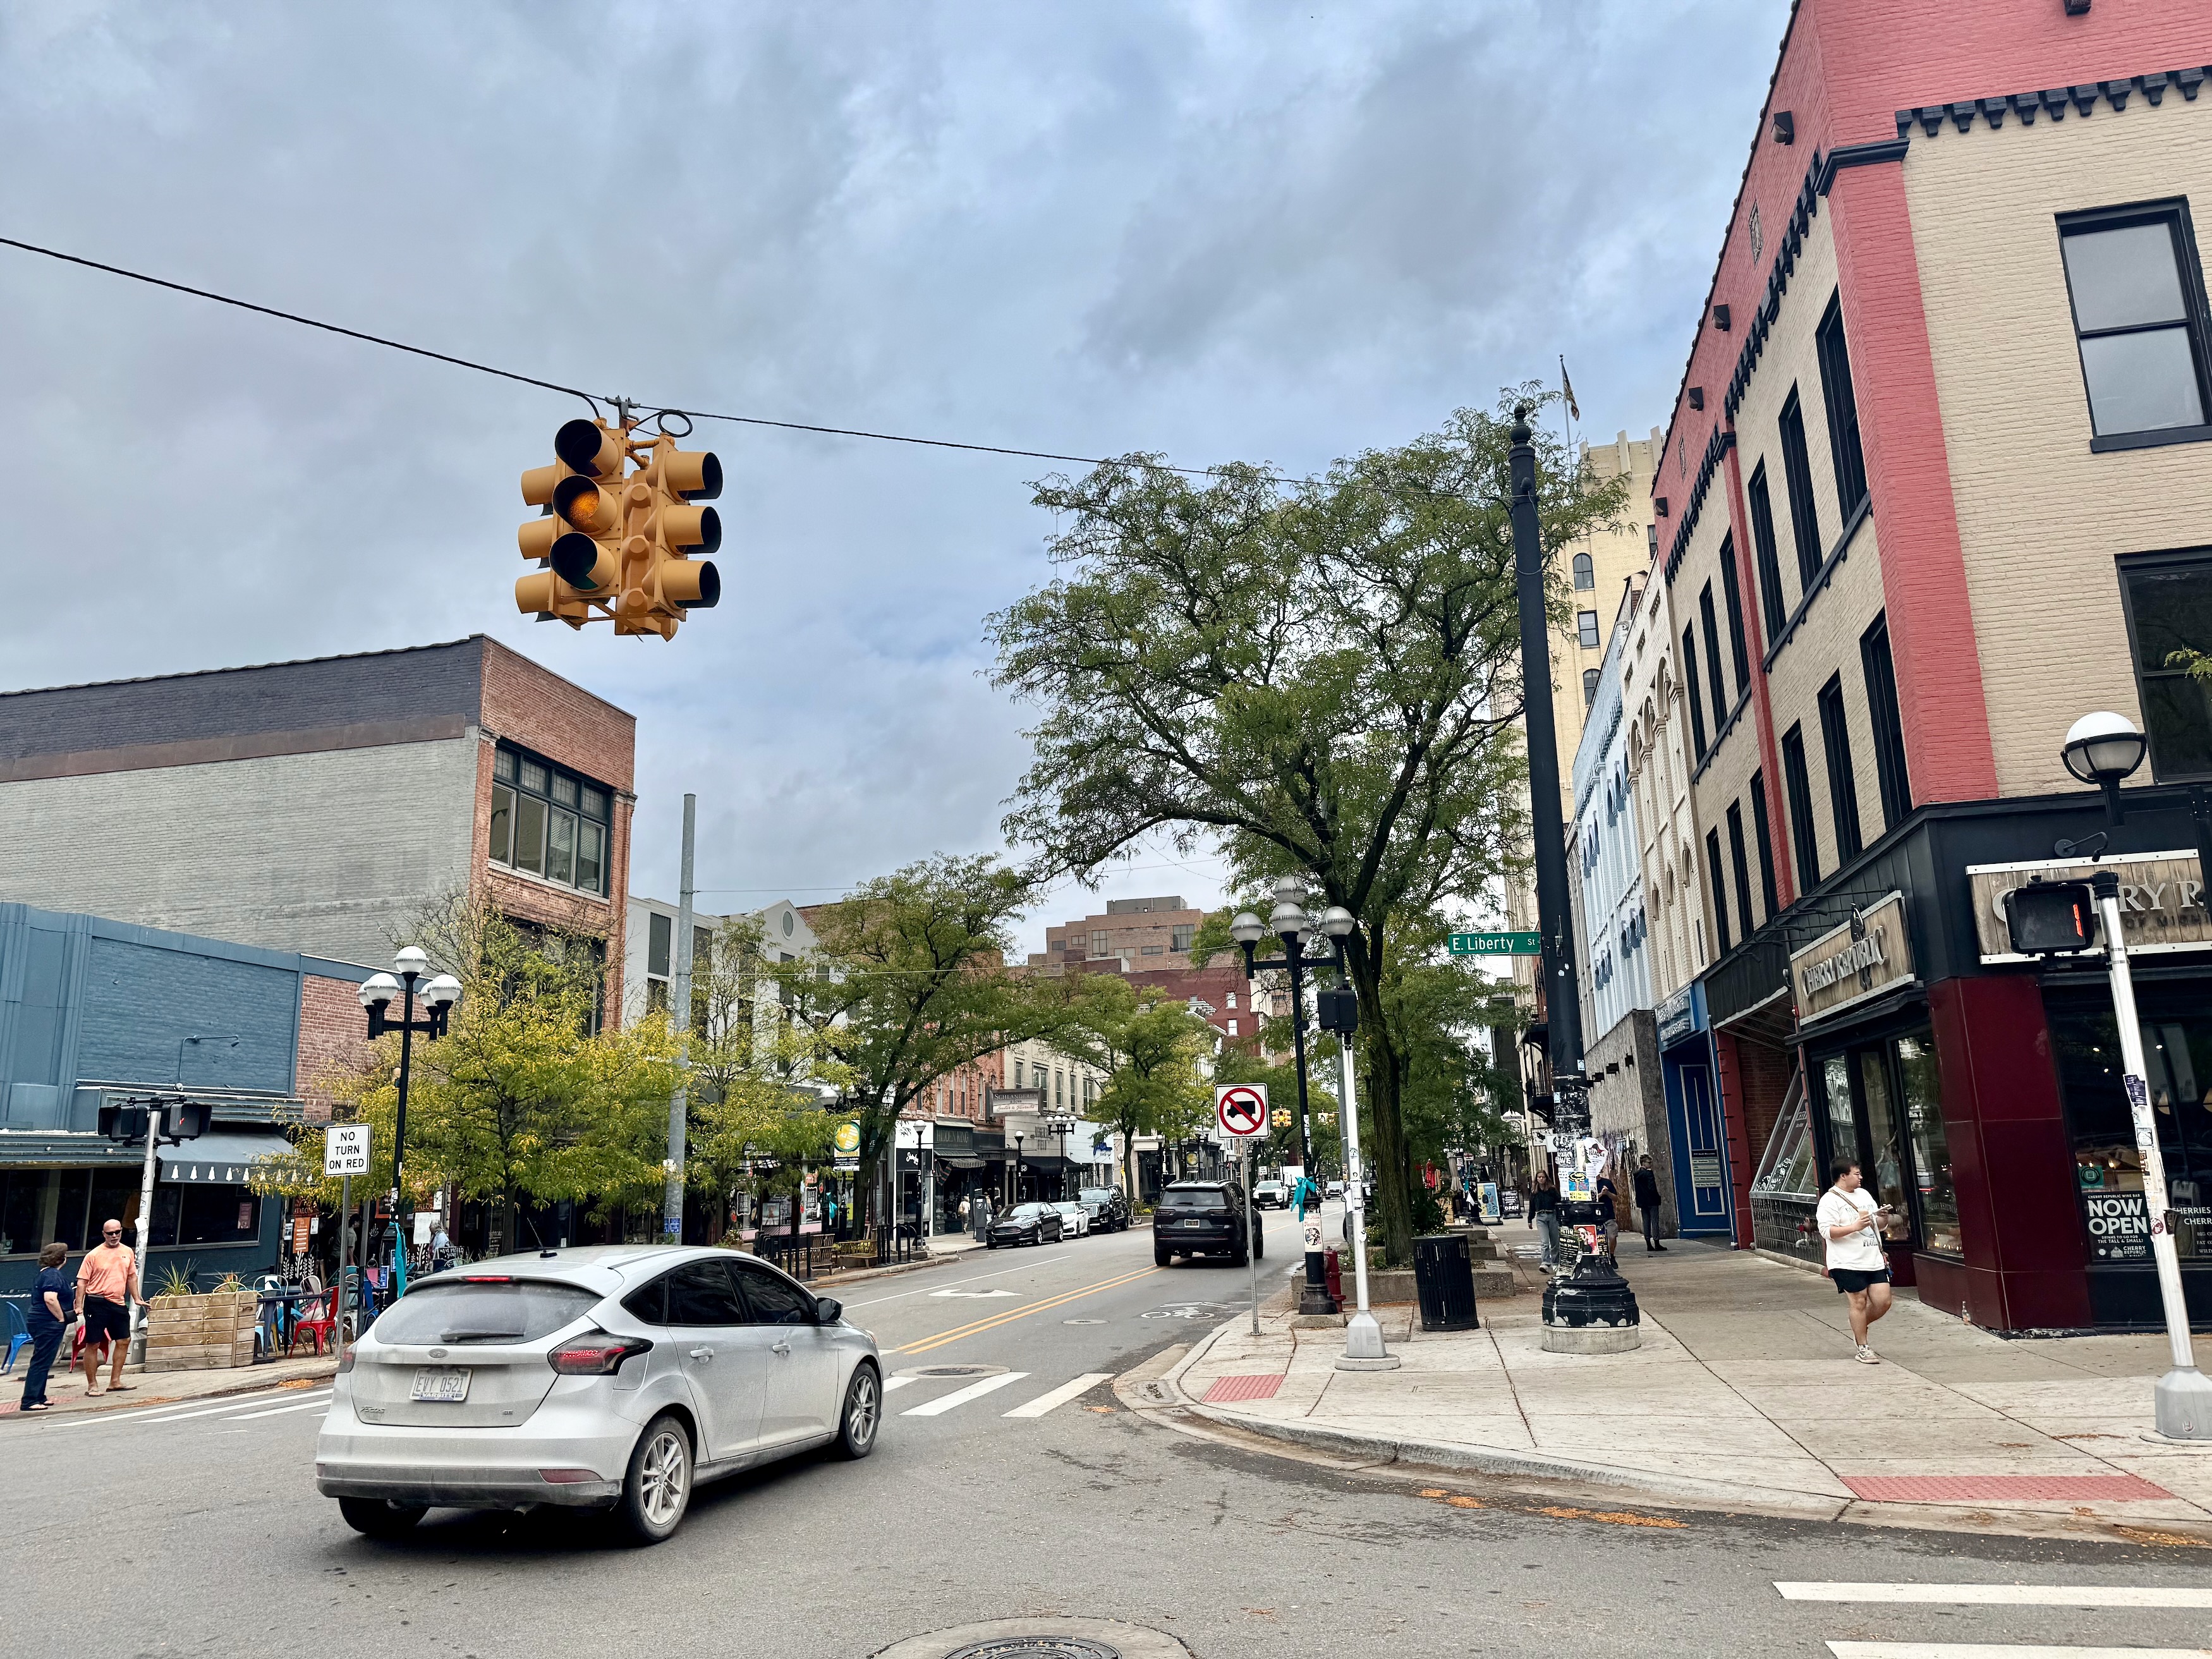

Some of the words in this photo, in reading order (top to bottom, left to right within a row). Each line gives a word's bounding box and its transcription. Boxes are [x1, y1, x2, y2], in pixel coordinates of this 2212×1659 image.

[1453, 938, 1463, 951] E.
[1468, 937, 1514, 952] Liberty
[1833, 925, 1887, 980] REPUBLIC
[341, 1132, 355, 1141] NO
[937, 1130, 955, 1142] HIDDEN
[957, 1131, 969, 1143] KING
[336, 1145, 360, 1155] TURN
[329, 1160, 341, 1169] ON
[347, 1158, 364, 1168] RED
[2087, 1199, 2142, 1217] NOW
[2088, 1217, 2148, 1235] OPEN
[416, 1376, 436, 1392] EVY
[441, 1376, 464, 1392] 0521
